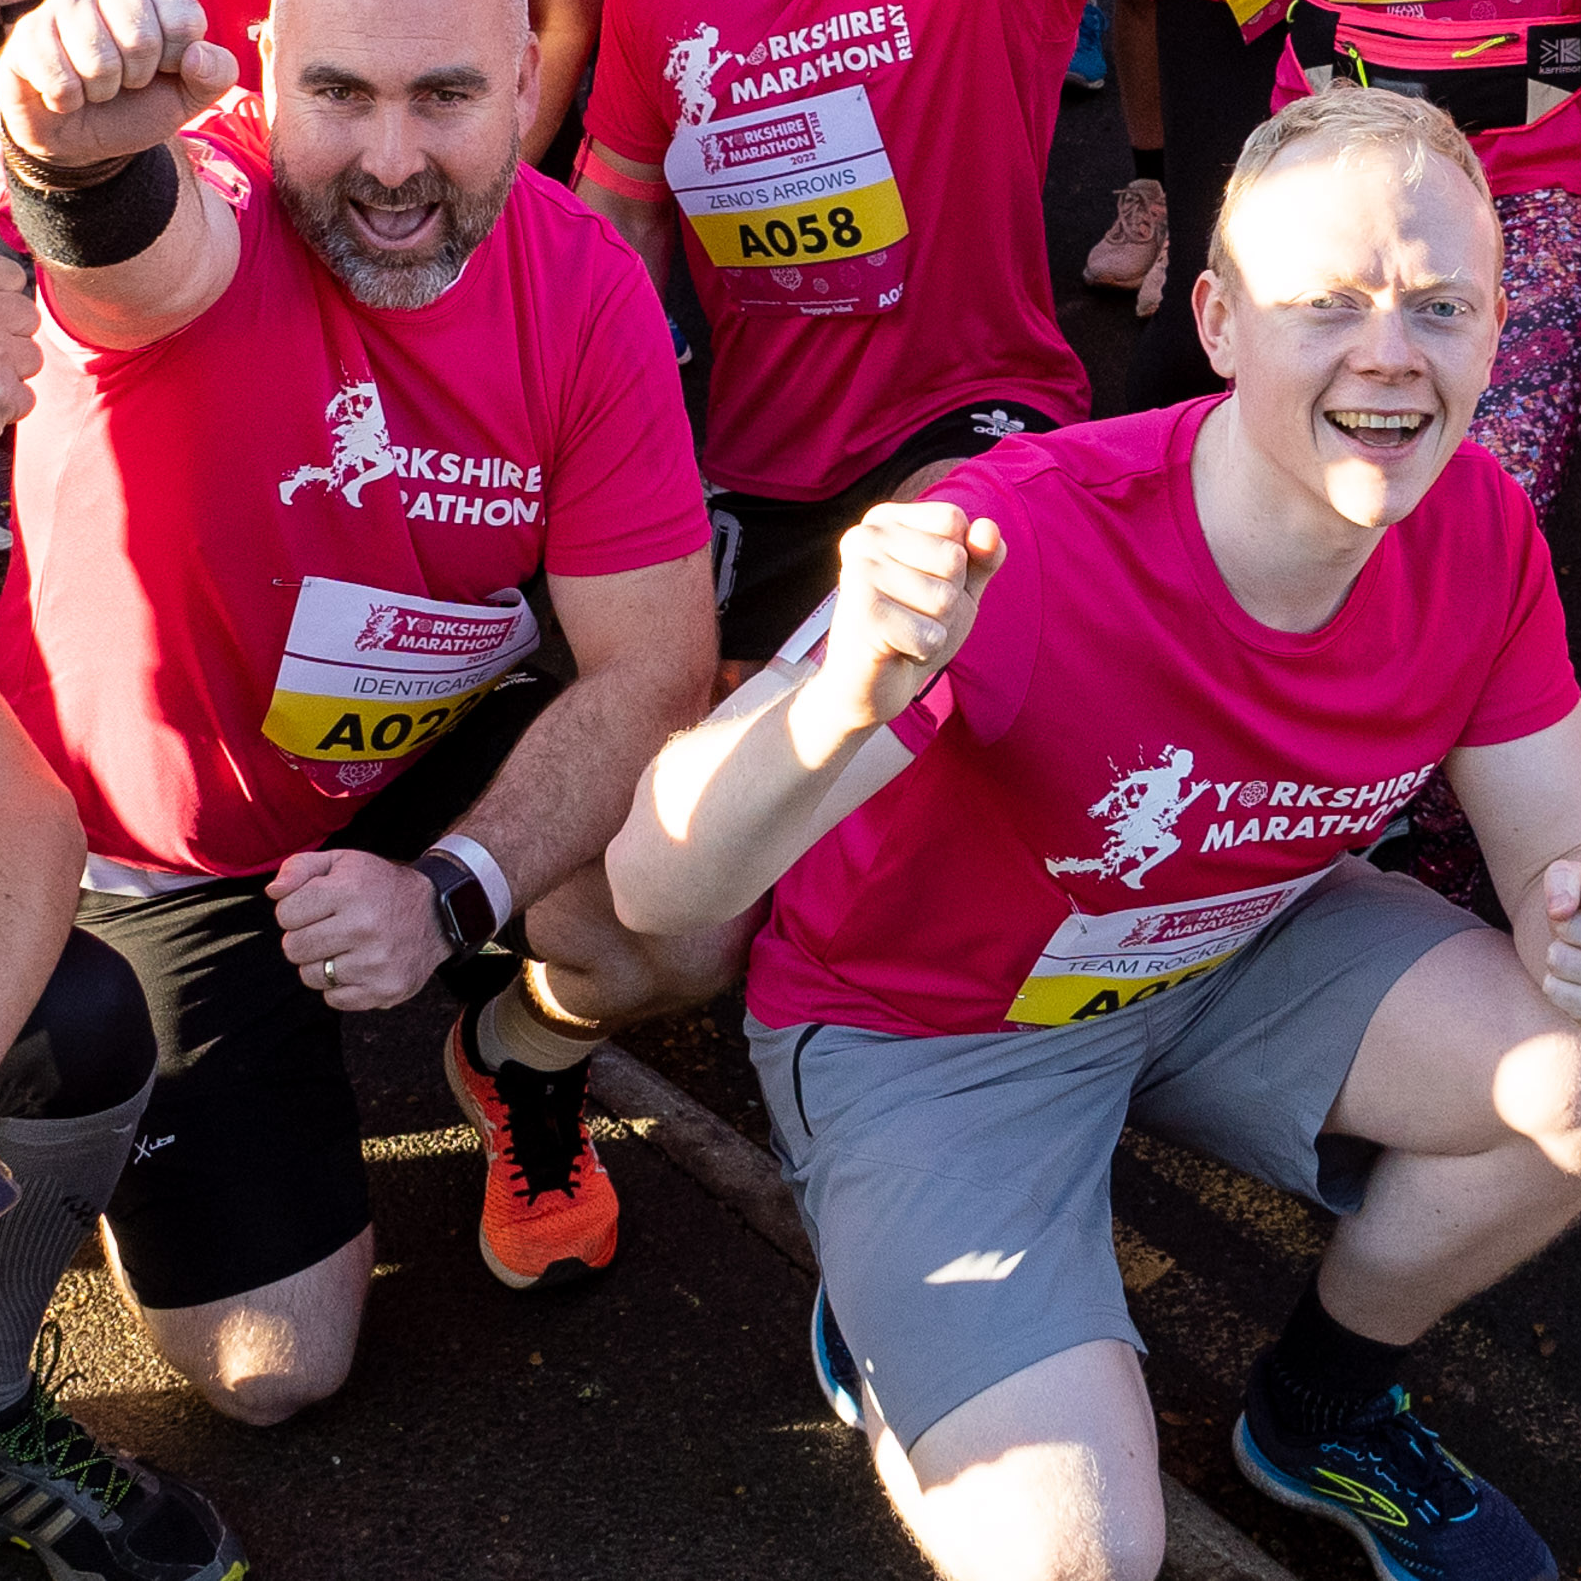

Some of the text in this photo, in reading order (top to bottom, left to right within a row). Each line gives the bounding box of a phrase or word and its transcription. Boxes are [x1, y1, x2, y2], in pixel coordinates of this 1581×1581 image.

[886, 2, 913, 62] RELAY
[724, 119, 806, 148] YORKSHIRE
[807, 111, 826, 146] RELAY
[729, 133, 811, 164] MARATHON
[790, 152, 817, 166] 2022
[706, 168, 857, 211] ZENO'S ARROWS
[739, 206, 863, 259] A058
[397, 634, 502, 652] MARATHON
[405, 617, 509, 637] YORKSHIRE
[353, 668, 492, 696] IDENTICARE
[1213, 762, 1436, 812] YORKSHIRE
[1199, 790, 1418, 853] MARATHON
[1163, 906, 1271, 939] MARATHON
[1171, 894, 1279, 925] YORKSHIRE
[1069, 937, 1246, 974] TEAM ROCKET
